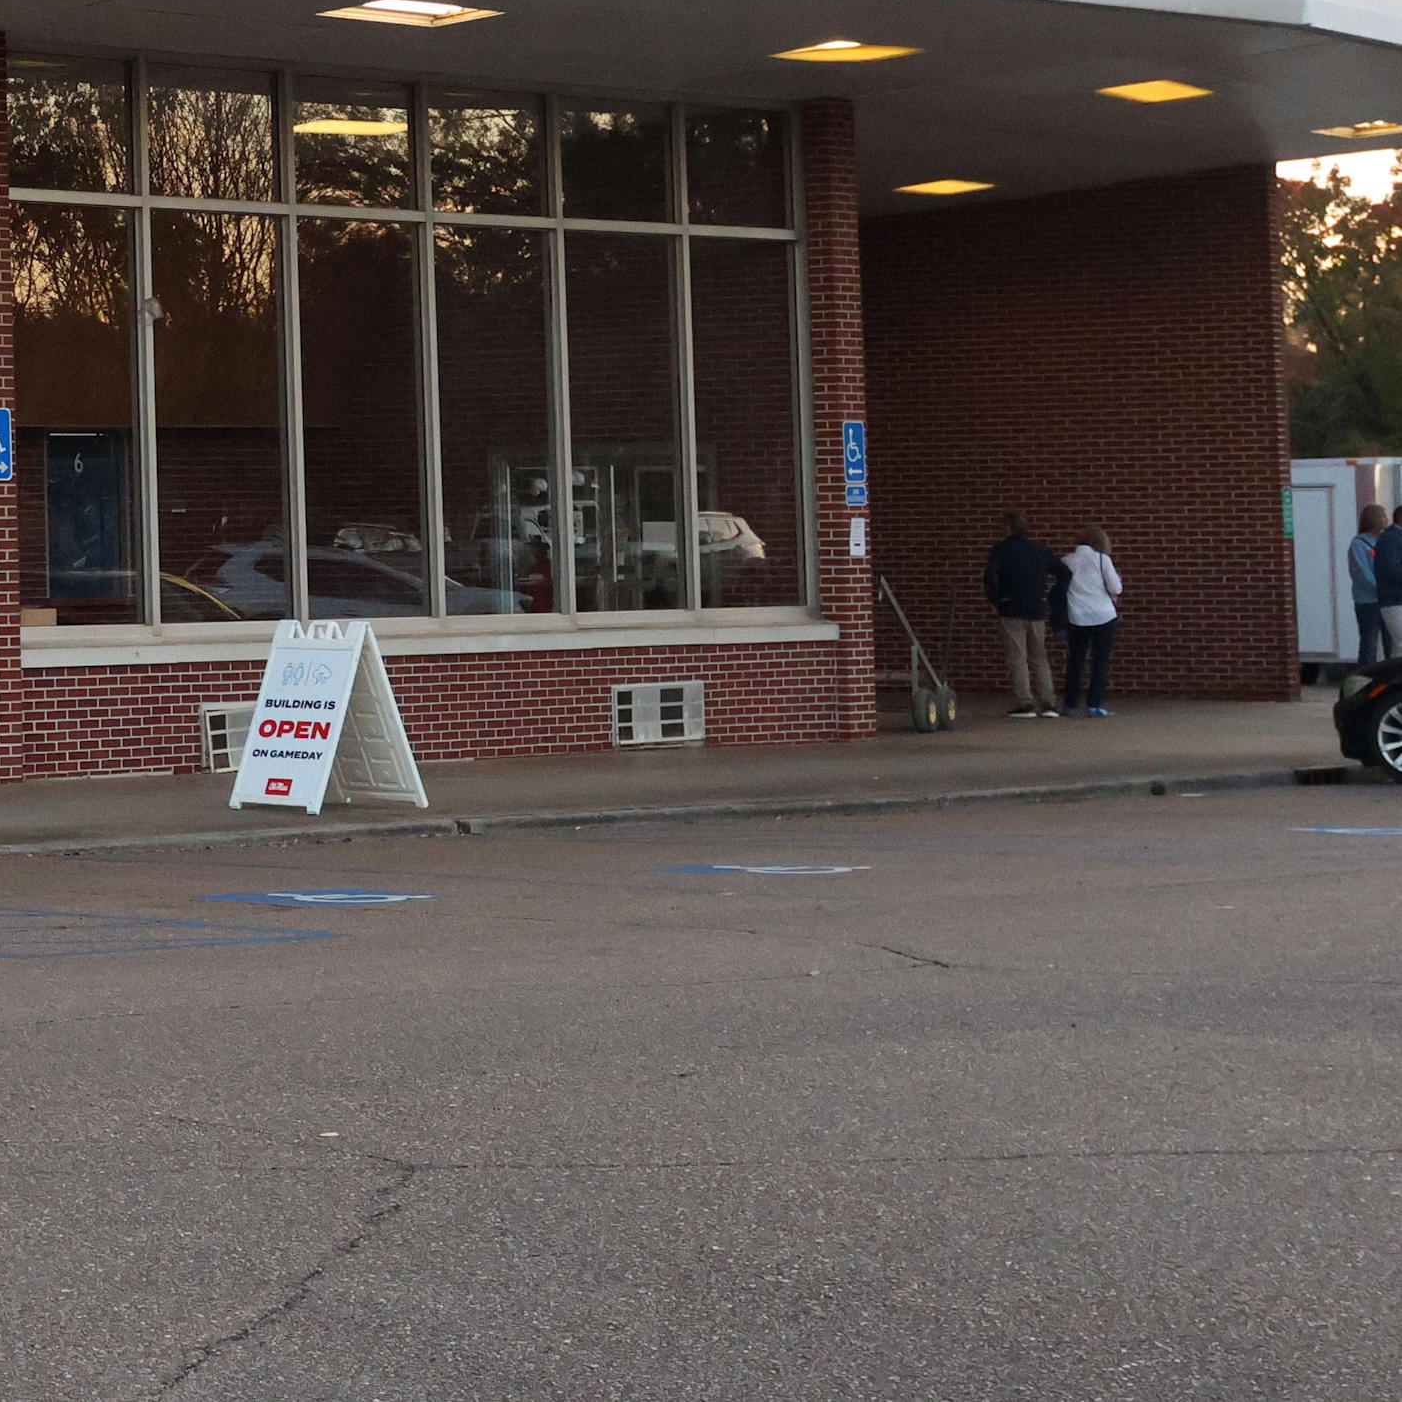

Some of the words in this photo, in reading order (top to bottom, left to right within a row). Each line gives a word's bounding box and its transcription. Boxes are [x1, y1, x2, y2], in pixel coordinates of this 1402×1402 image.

[74, 452, 83, 473] 6
[265, 699, 322, 709] BUILDING
[324, 701, 336, 710] IS
[258, 719, 331, 739] OPEN
[252, 749, 268, 757] ON
[270, 750, 323, 760] GAMEDAY
